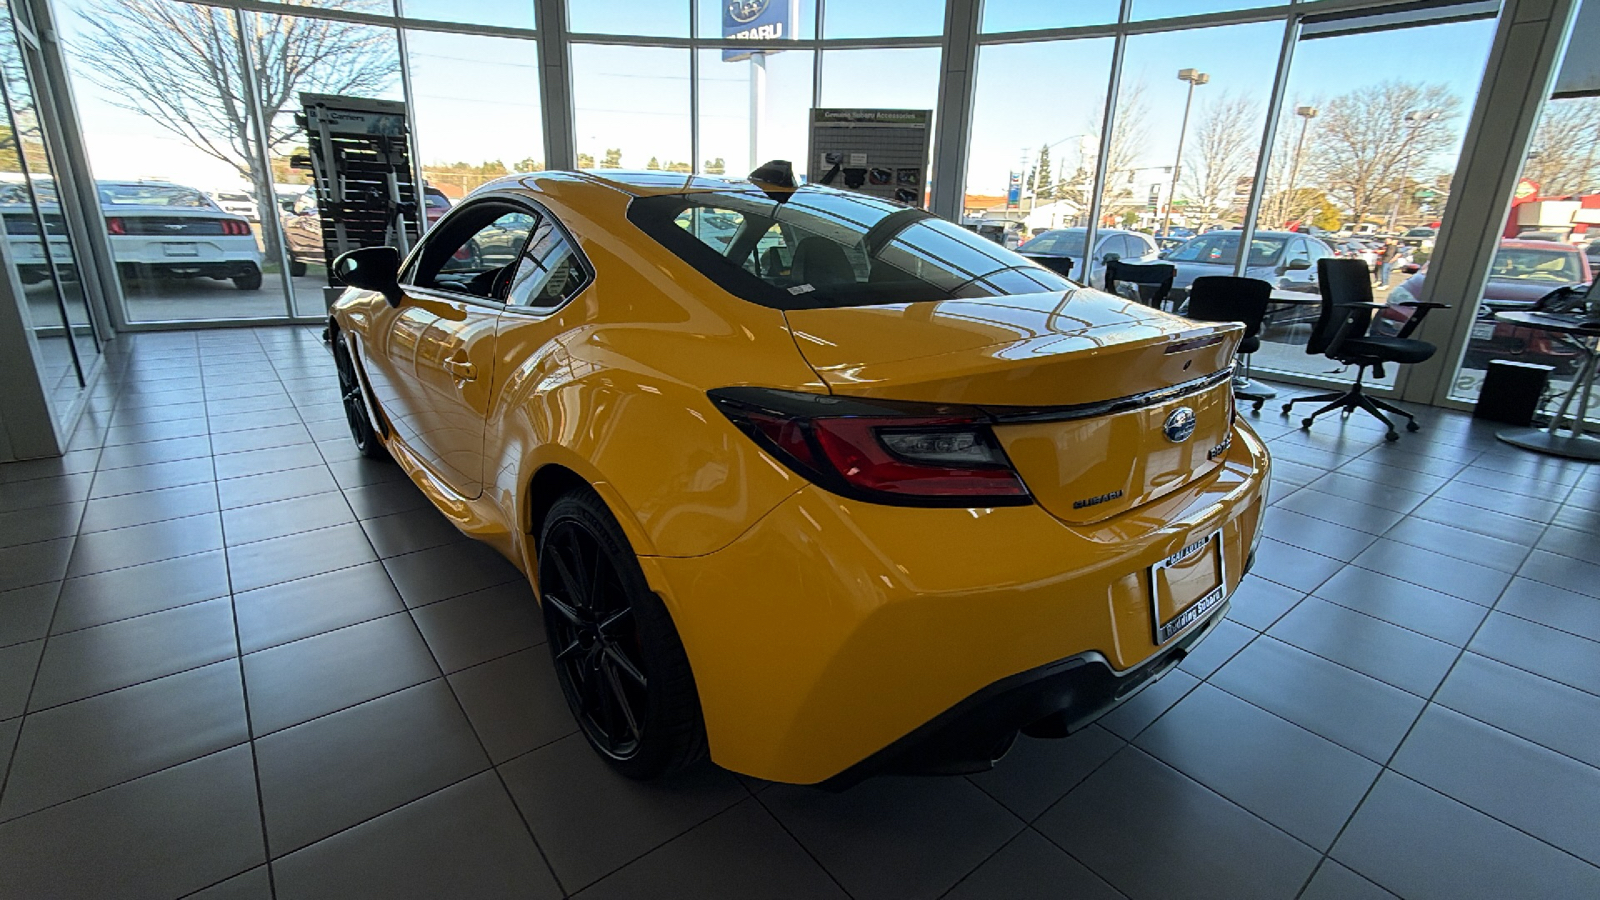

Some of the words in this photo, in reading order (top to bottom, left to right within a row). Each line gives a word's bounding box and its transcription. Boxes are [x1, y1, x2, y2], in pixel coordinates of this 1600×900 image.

[726, 22, 782, 39] BARU
[852, 111, 875, 119] Subaru
[1073, 490, 1123, 509] SUBARU
[1197, 590, 1220, 614] Subaru
